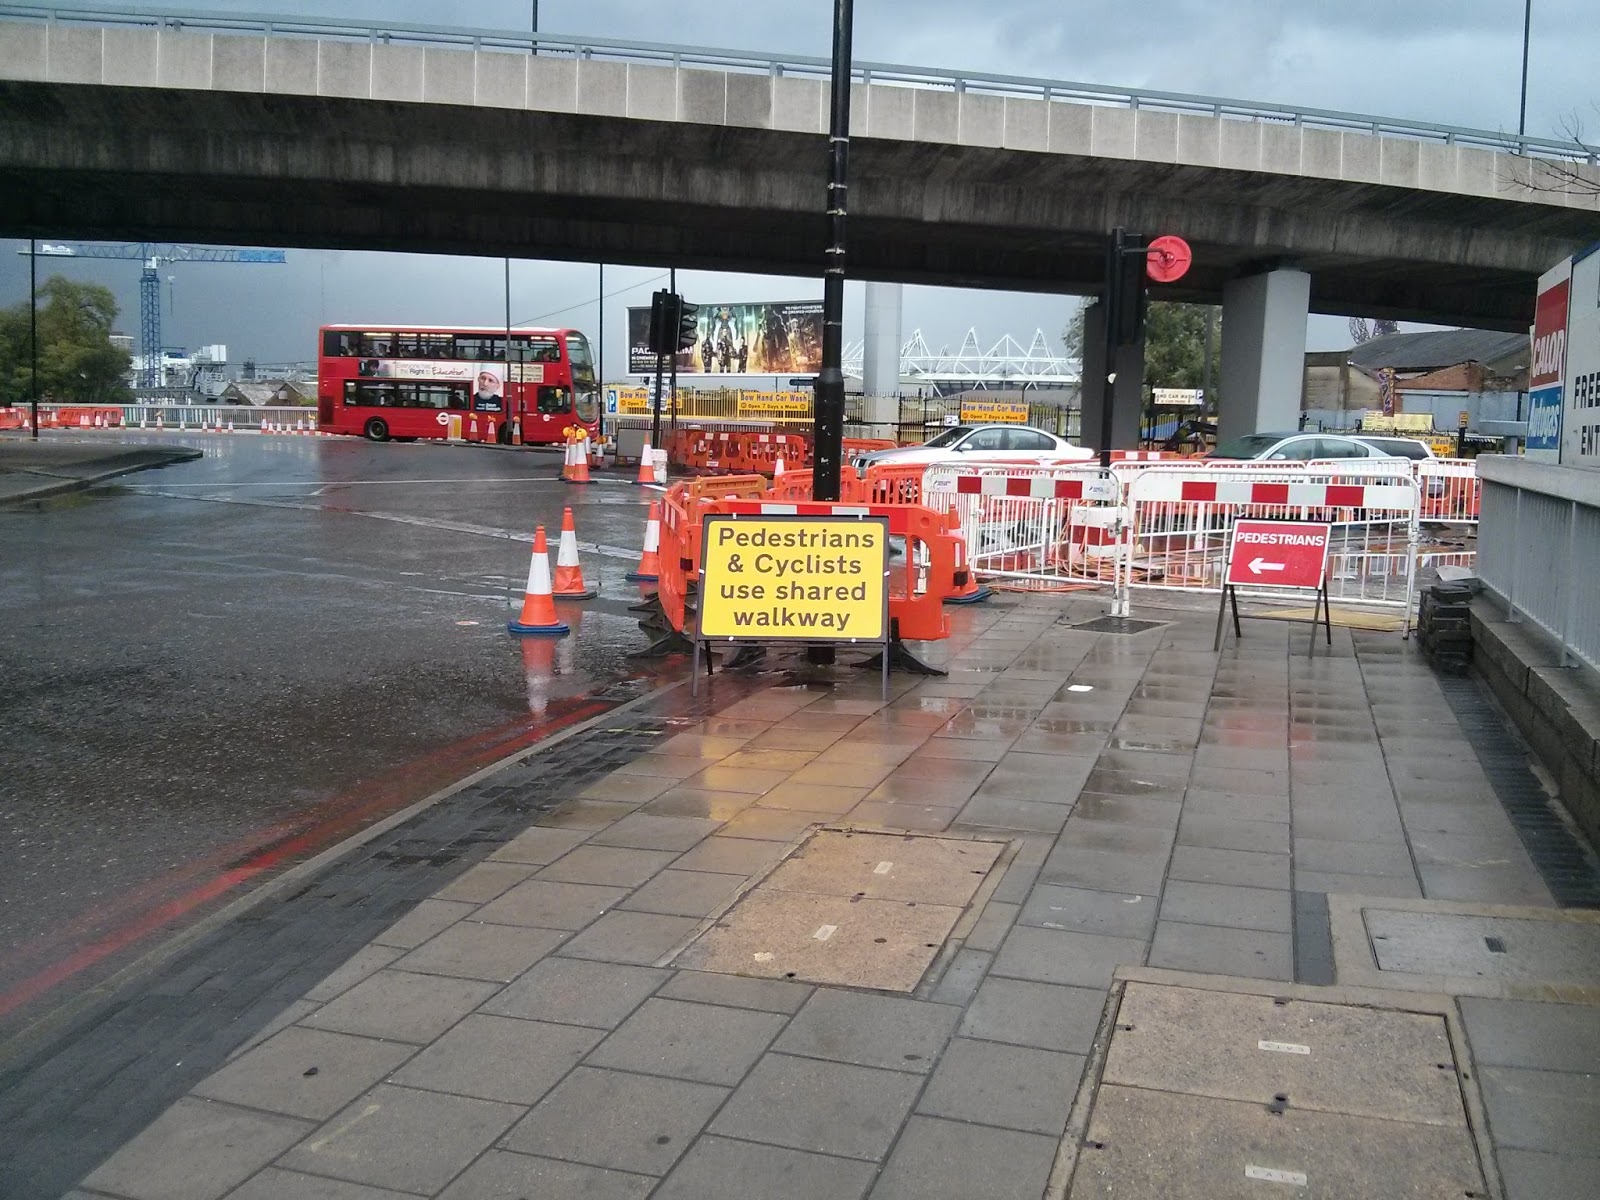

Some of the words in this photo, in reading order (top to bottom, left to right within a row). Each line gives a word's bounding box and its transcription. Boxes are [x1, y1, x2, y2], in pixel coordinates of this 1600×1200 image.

[1533, 329, 1564, 381] CALOR
[756, 394, 773, 402] Hand
[776, 394, 787, 402] Car
[790, 394, 807, 402] Wash
[962, 403, 976, 411] Bow
[978, 404, 995, 412] Hand
[996, 404, 1008, 412] Car
[1010, 404, 1027, 413] Wash
[1527, 397, 1560, 444] Autogas
[718, 527, 875, 548] Pedestrians
[1236, 531, 1325, 547] PEDESTRIANS
[727, 553, 744, 573] &
[754, 553, 862, 578] Cyclists
[720, 583, 765, 600] use
[775, 580, 866, 601] shared
[733, 606, 851, 632] walkway
